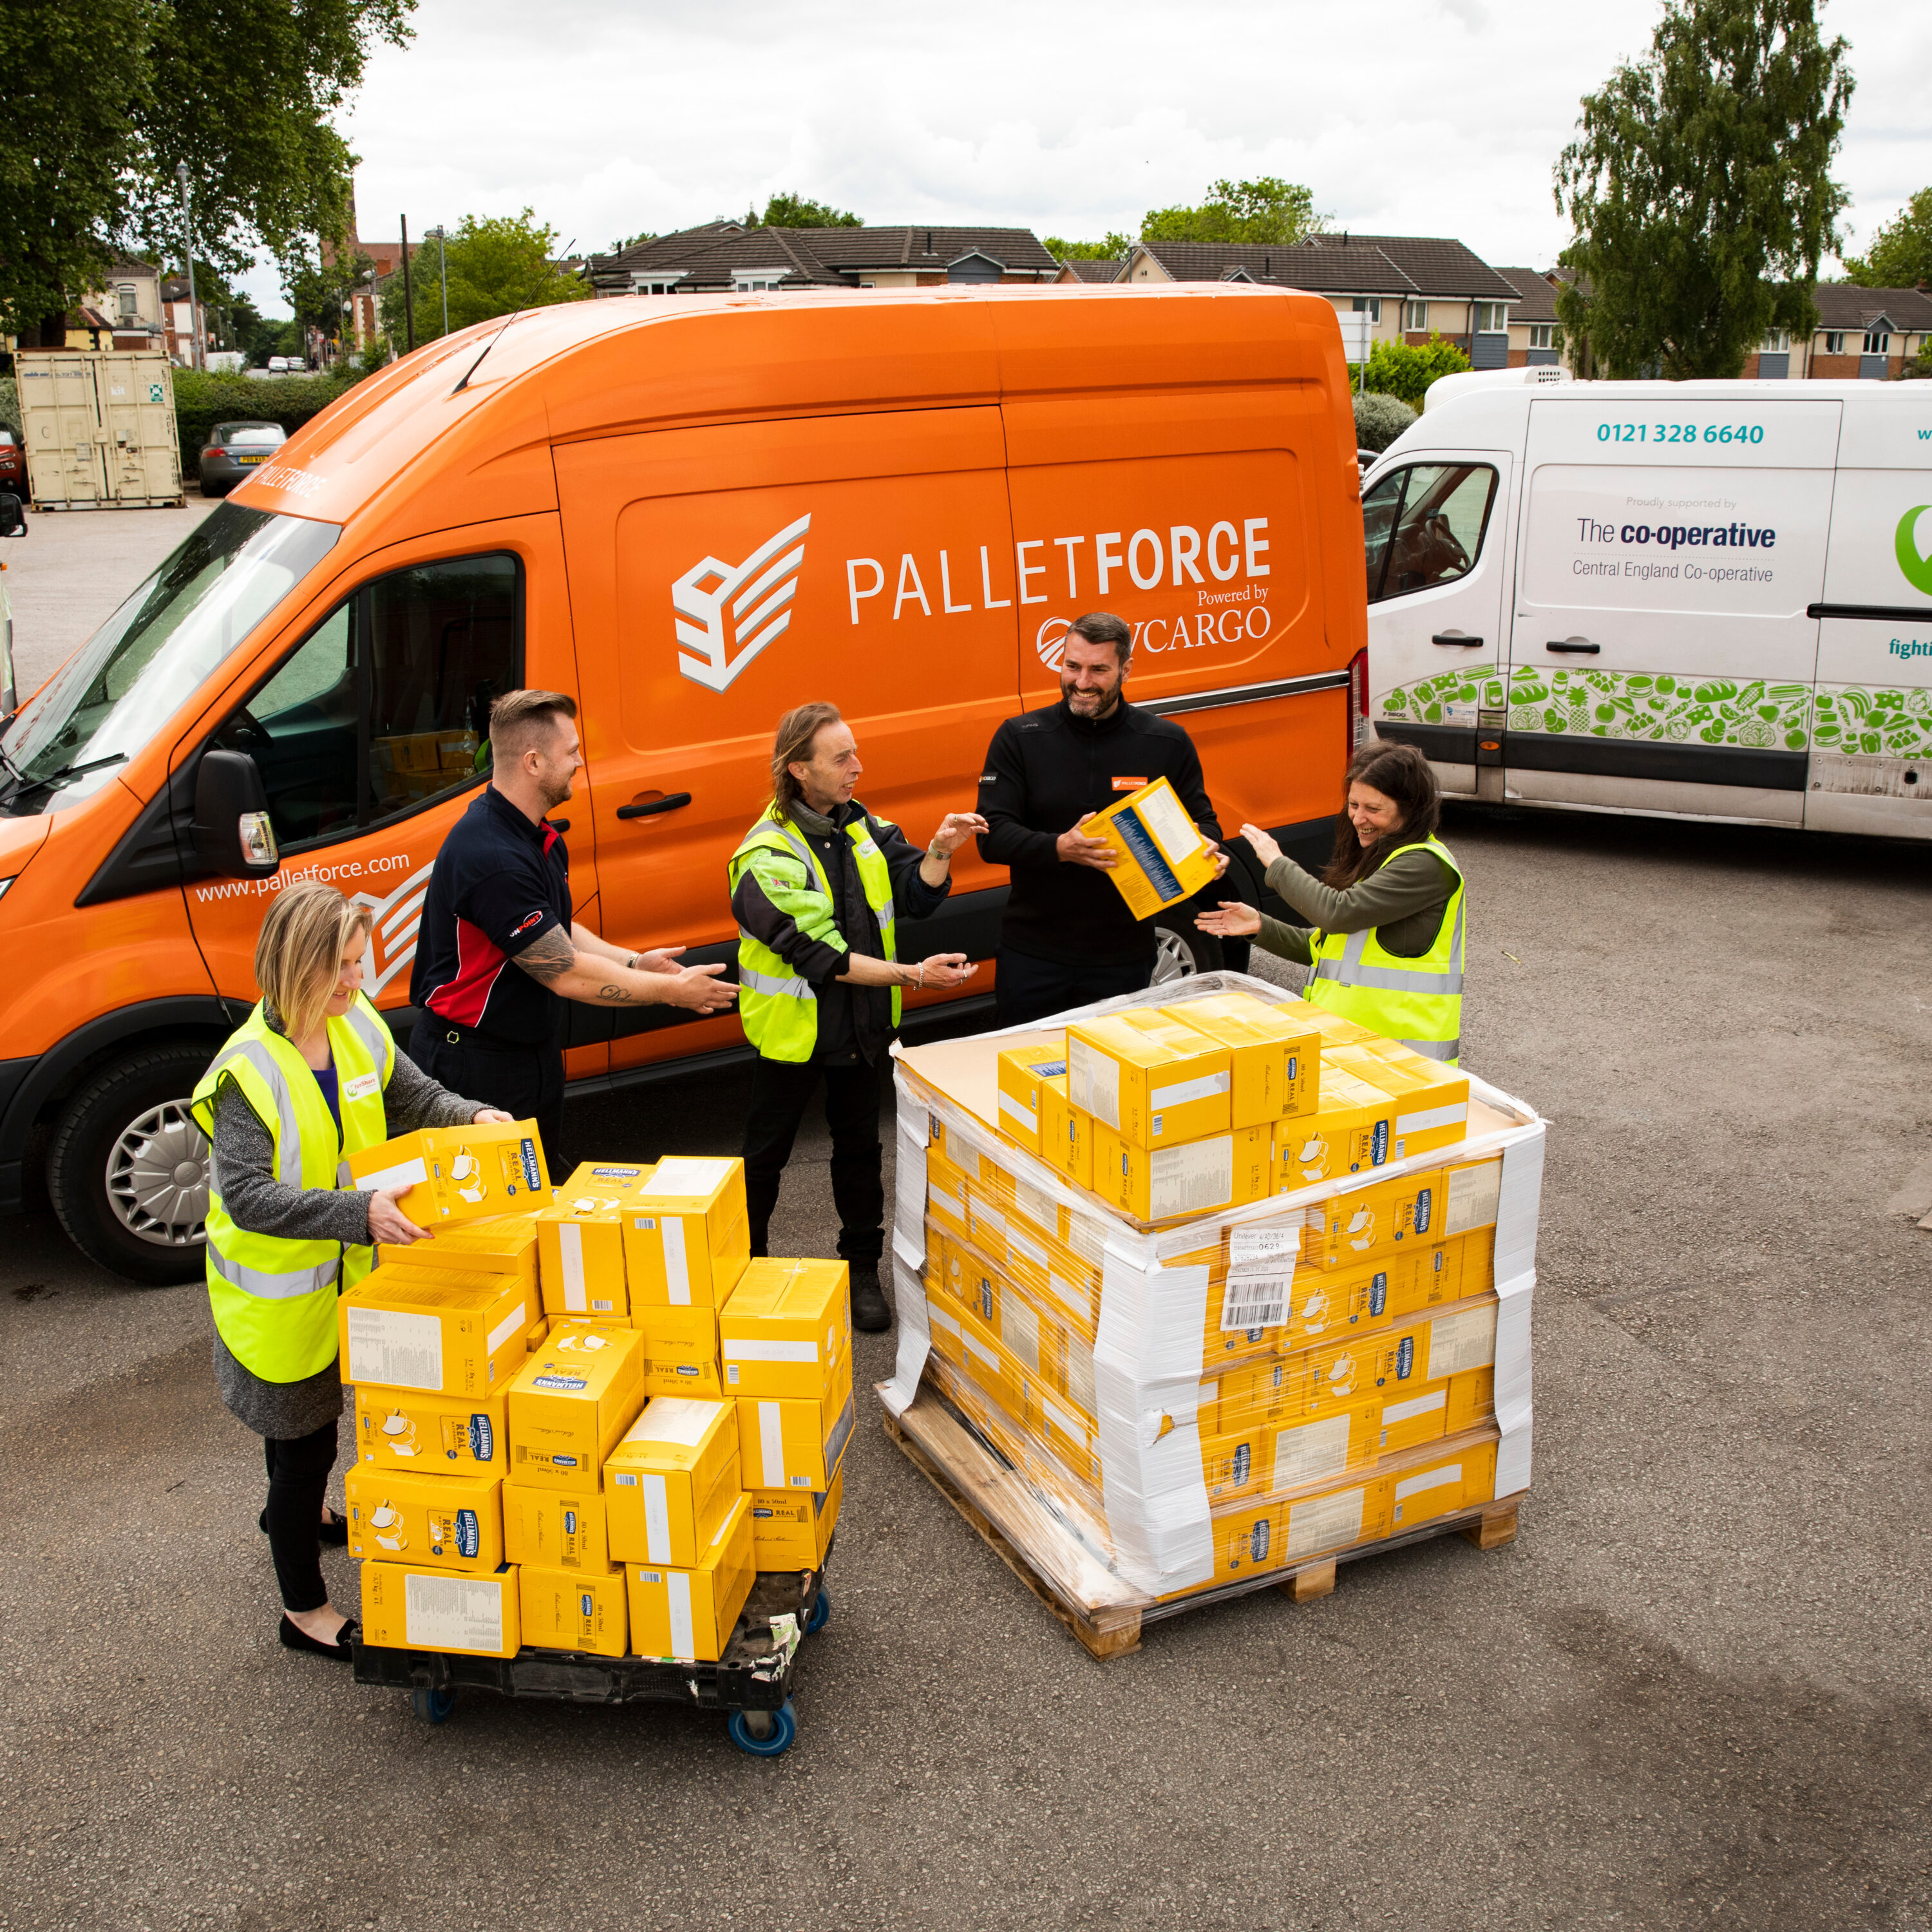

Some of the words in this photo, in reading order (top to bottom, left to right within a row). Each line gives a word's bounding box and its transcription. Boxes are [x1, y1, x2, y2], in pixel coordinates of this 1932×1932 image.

[111, 386, 125, 395] kit
[1597, 424, 1646, 442] 0121
[1653, 424, 1697, 442] 328
[1703, 424, 1764, 444] 6640
[254, 466, 327, 498] PALLETFORCE
[1626, 497, 1664, 508] Proudly
[1668, 498, 1720, 509] supported
[1724, 499, 1737, 510] by
[1577, 518, 1615, 542] The
[1620, 522, 1776, 551] co-operative
[846, 517, 1271, 625] PALLETFORCE
[1573, 560, 1620, 576] Central
[1625, 562, 1679, 580] England
[1684, 564, 1774, 583] Co-operative
[1197, 584, 1251, 606] Powered
[1253, 583, 1269, 603] by
[196, 853, 410, 902] www.palletforce.com
[1376, 1122, 1385, 1163] HELLMANN'S
[511, 1152, 521, 1181] REAL
[524, 1141, 540, 1188] HELLMANN'S
[1419, 1191, 1428, 1231] HELLMANN'S
[1375, 1274, 1383, 1314] HELLMANN'S
[1402, 1338, 1410, 1377] HELLMANN'S
[535, 1379, 584, 1389] HELLMANN'S
[456, 1423, 466, 1449] REAL
[477, 1416, 489, 1459] HELLMANN'S
[554, 1458, 576, 1466] HELLMANN'S
[442, 1518, 451, 1545] REAL
[463, 1511, 476, 1555] HELLMANN'S
[1257, 1521, 1267, 1559] HELLMANN'S
